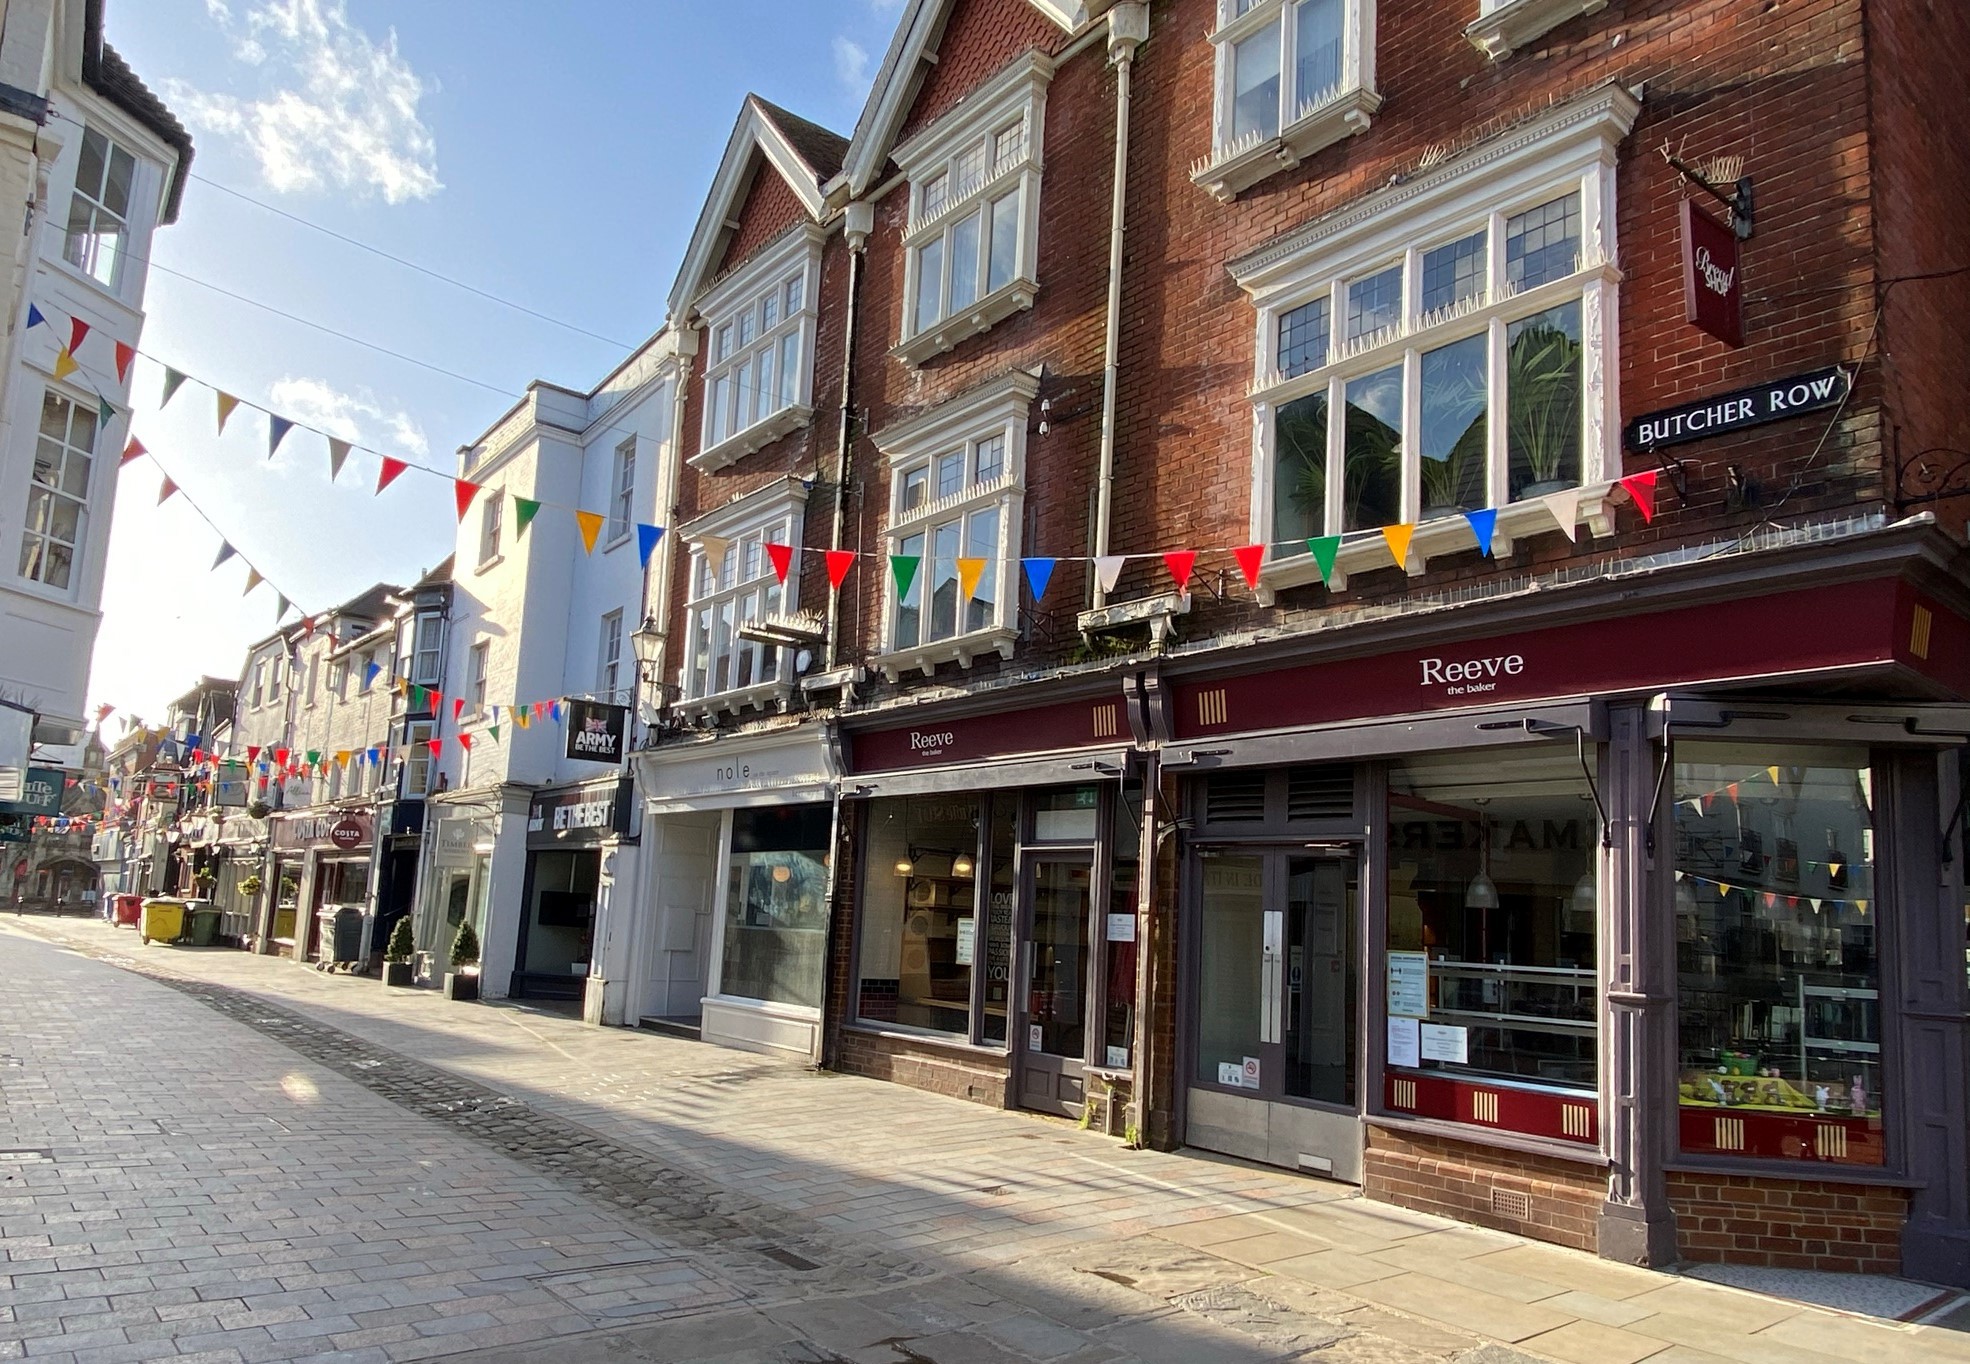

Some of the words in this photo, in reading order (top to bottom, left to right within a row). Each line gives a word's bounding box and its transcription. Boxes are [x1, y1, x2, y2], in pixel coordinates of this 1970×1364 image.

[1696, 246, 1735, 288] Bread
[1638, 397, 1756, 445] BUTCHER
[1769, 376, 1836, 411] ROW
[1419, 654, 1524, 686] Reeve
[1447, 685, 1465, 696] the
[1466, 682, 1497, 694] baker
[575, 731, 616, 746] ARMY
[910, 731, 953, 750] Reeve
[598, 746, 615, 754] BEST
[717, 756, 750, 780] nole
[553, 806, 566, 830] BE
[585, 800, 612, 827] BEST
[335, 829, 360, 838] COSTA
